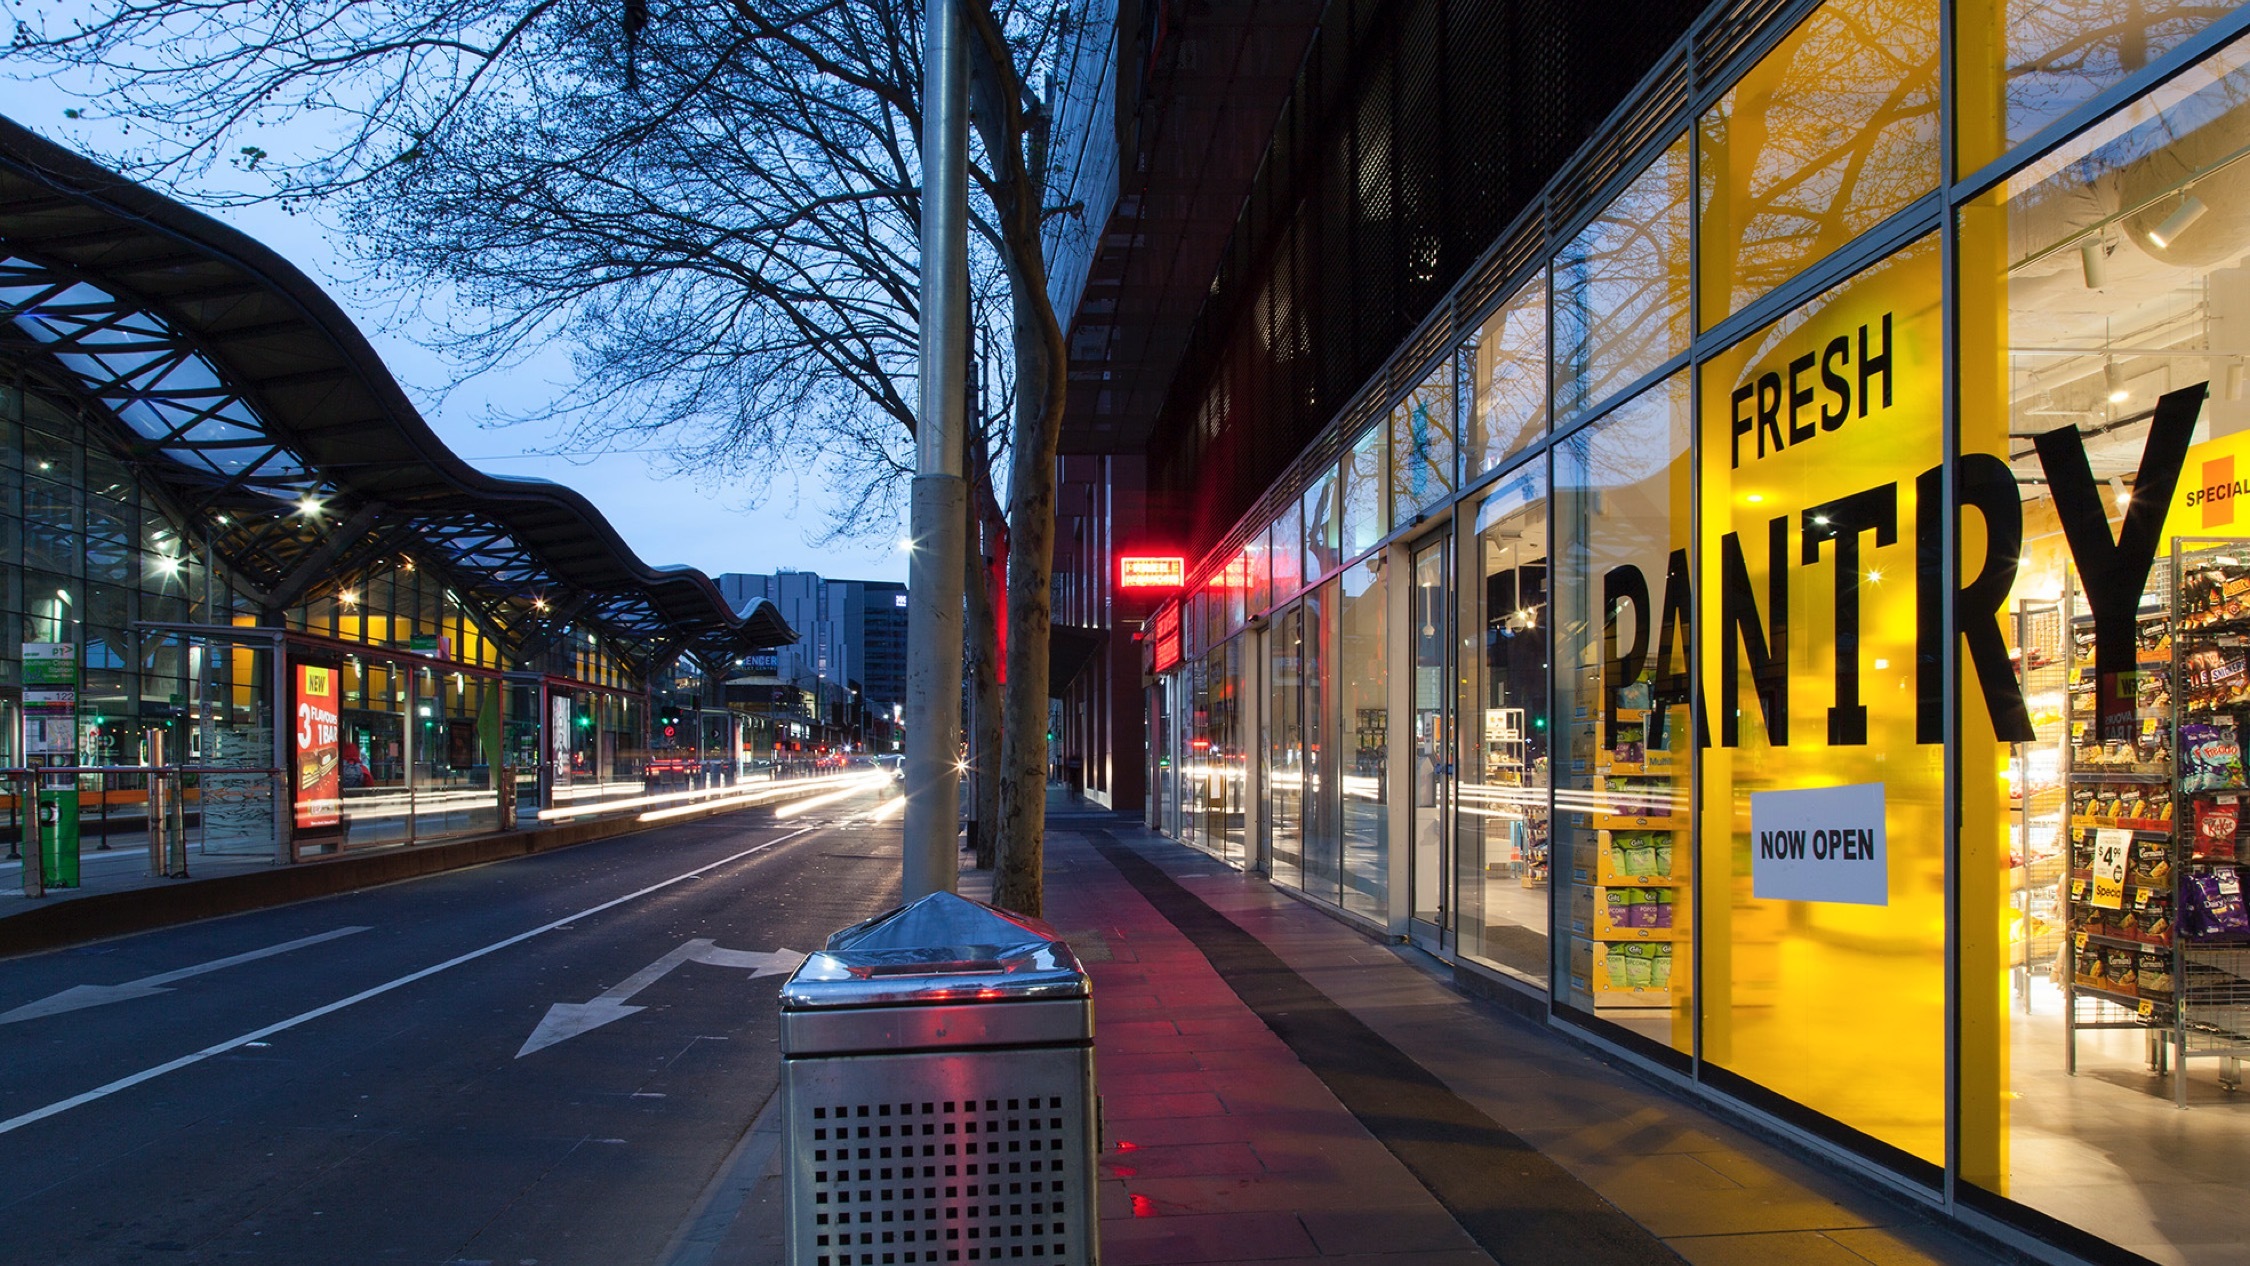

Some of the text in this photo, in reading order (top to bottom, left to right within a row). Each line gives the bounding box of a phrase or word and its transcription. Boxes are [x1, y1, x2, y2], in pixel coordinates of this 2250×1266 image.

[1732, 311, 1892, 469] FRESH
[1604, 382, 2209, 750] PANTRY
[741, 655, 777, 666] ENCER
[309, 674, 326, 693] NEW
[56, 692, 74, 701] 122
[298, 702, 312, 750] 3
[1761, 828, 1874, 860] NOW OPEN
[2096, 884, 2121, 899] Specia
